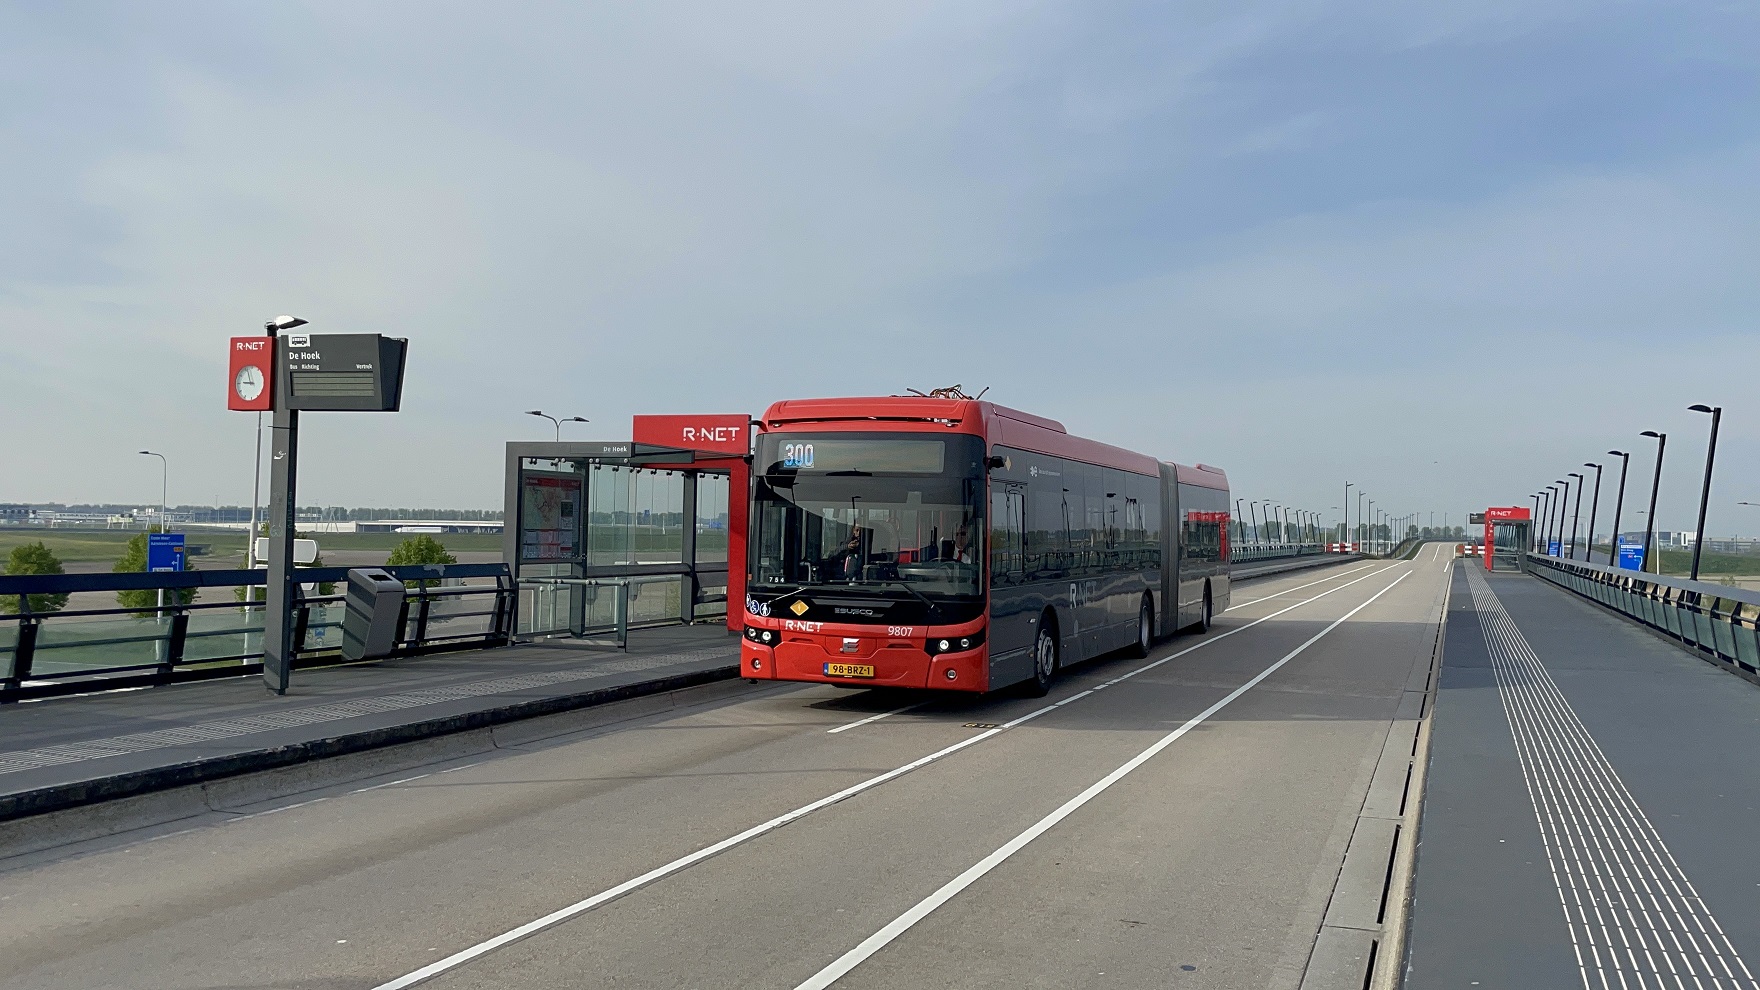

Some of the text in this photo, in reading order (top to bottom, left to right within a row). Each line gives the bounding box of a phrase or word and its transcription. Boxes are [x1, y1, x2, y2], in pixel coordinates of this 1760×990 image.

[289, 351, 320, 360] De Hoek
[785, 444, 814, 467] 300
[834, 607, 873, 615] EBUSCO
[888, 626, 913, 637] 9807
[832, 665, 870, 676] 98-BRZ-1
